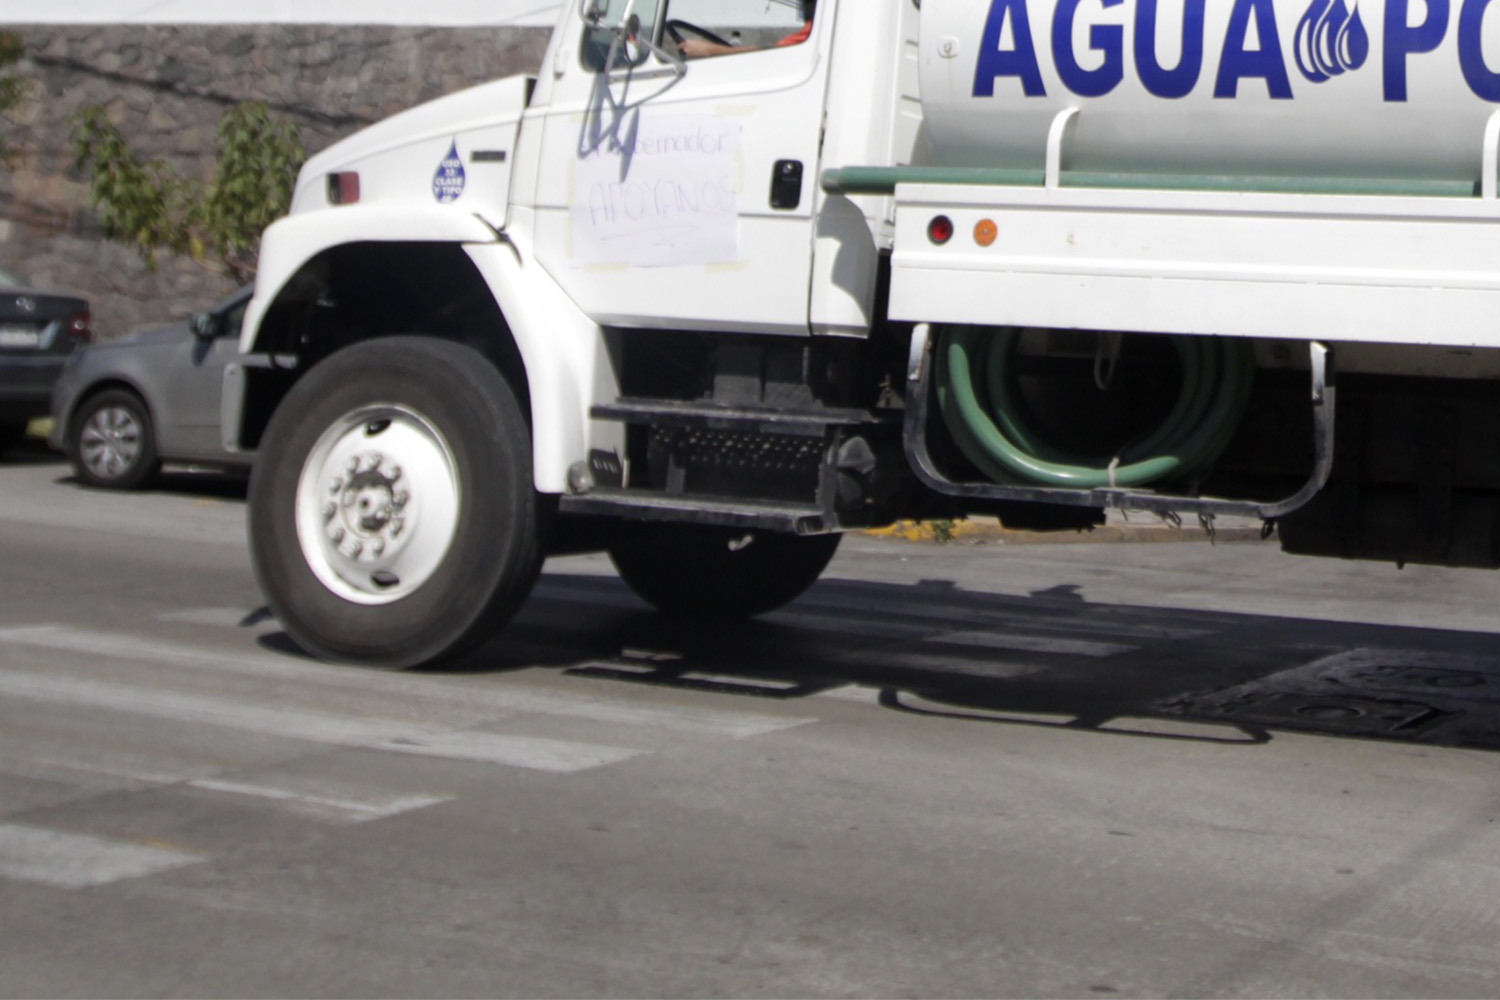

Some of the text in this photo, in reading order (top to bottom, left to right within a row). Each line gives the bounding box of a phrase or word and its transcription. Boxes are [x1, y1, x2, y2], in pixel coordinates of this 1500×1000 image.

[442, 159, 460, 168] USO
[435, 177, 463, 186] CLASE
[442, 186, 462, 194] TIPO
